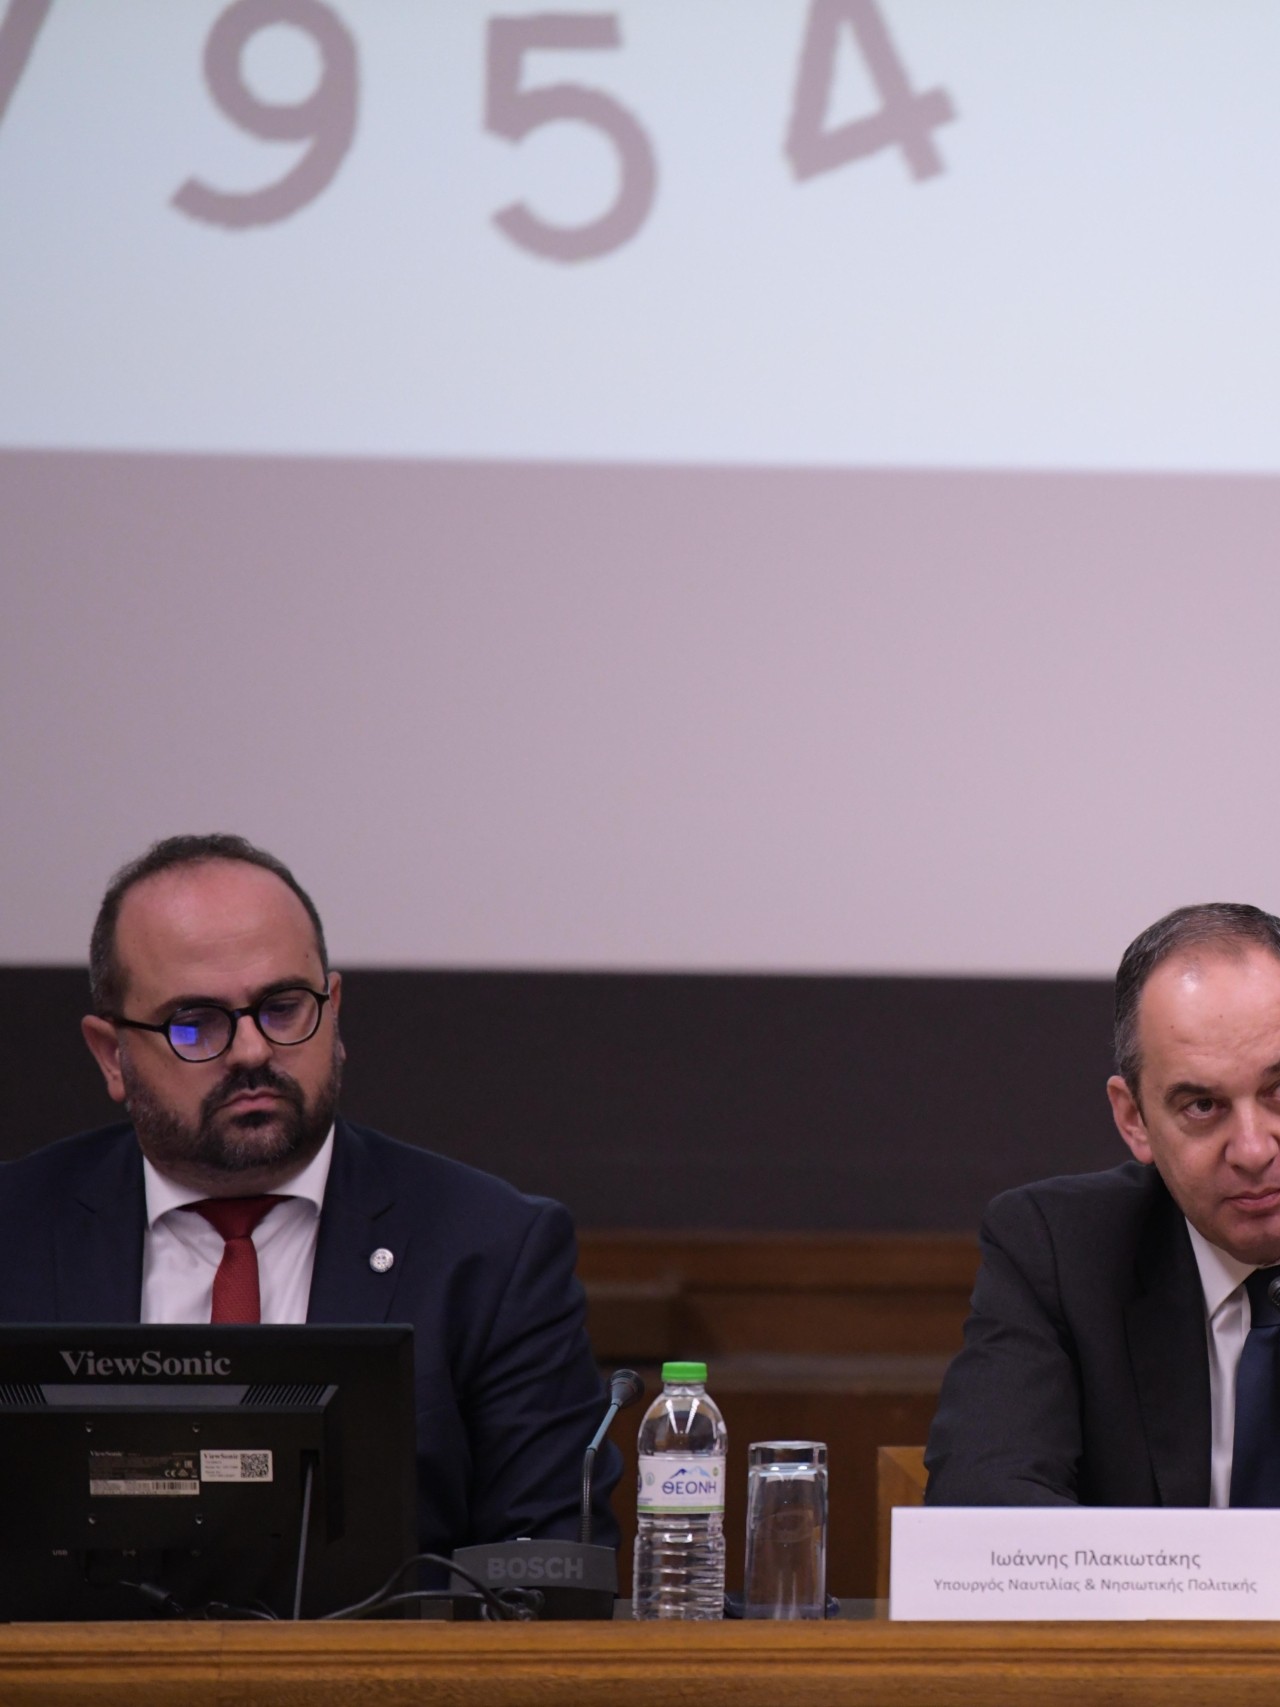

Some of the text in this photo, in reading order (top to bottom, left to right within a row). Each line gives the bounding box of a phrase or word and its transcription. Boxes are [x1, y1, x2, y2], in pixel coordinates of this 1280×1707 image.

[60, 1350, 231, 1376] ViewSonic
[662, 1481, 717, 1495] ΘΕΟΝΗ
[487, 1556, 584, 1581] BOSCH
[990, 1549, 1201, 1570] Ιωάννης Πλακιωτάκης
[933, 1578, 1258, 1593] Υπουργός Ναυτιλίας & Νησιωτικής Πολιτικής
